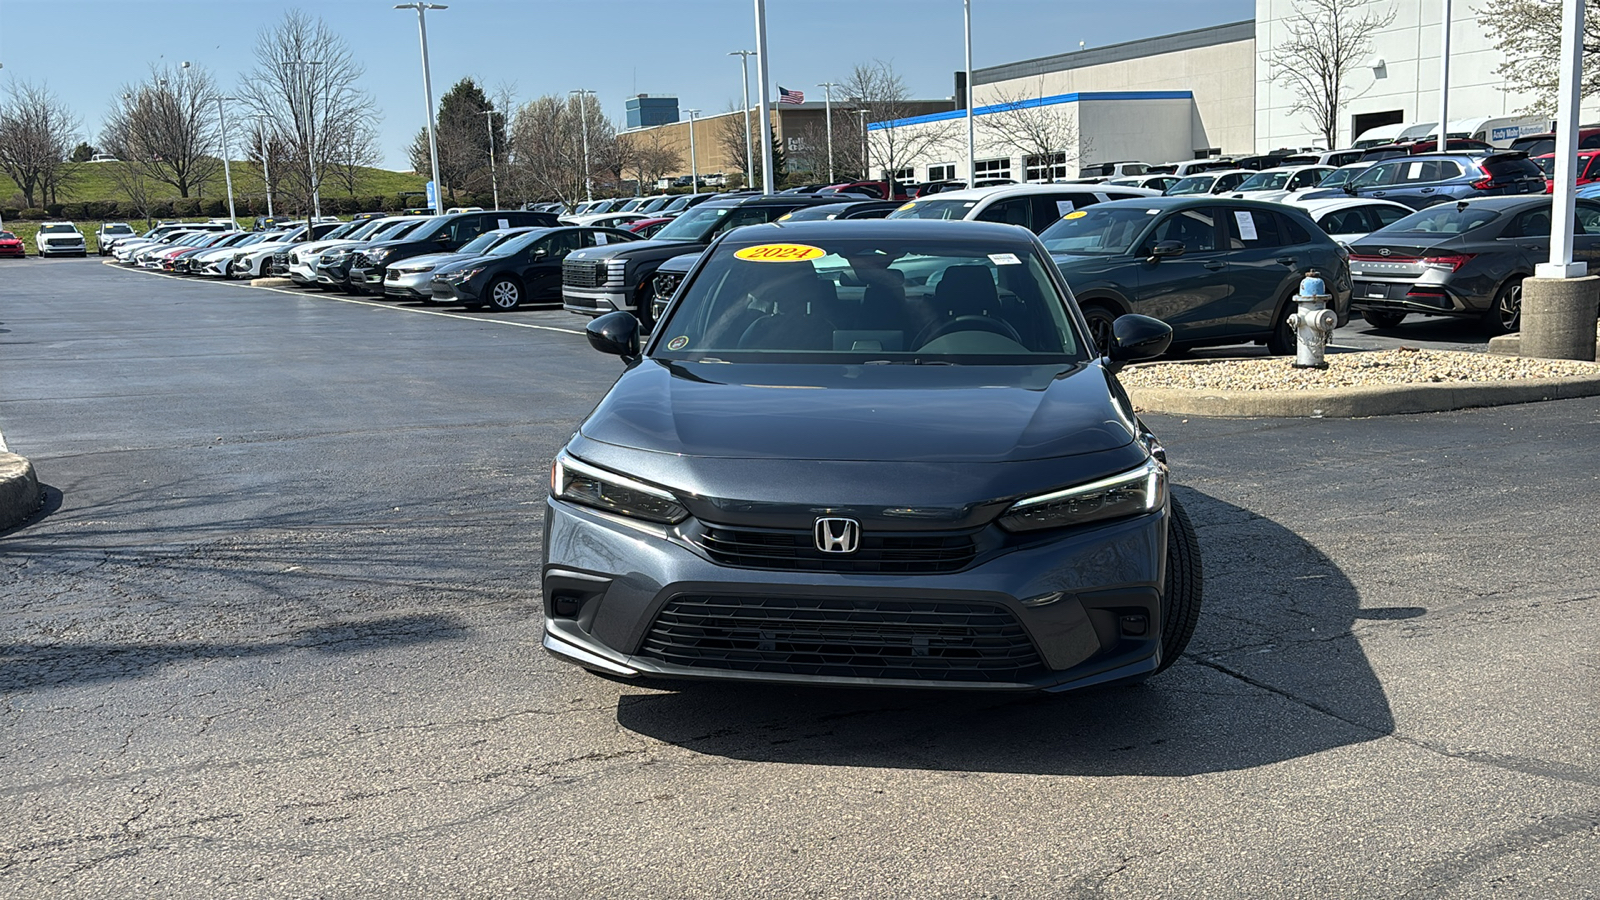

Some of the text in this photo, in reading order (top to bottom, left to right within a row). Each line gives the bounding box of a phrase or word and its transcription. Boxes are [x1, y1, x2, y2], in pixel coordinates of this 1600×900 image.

[1493, 130, 1506, 140] Andy
[1506, 128, 1519, 138] Mohr
[747, 247, 813, 259] 2024
